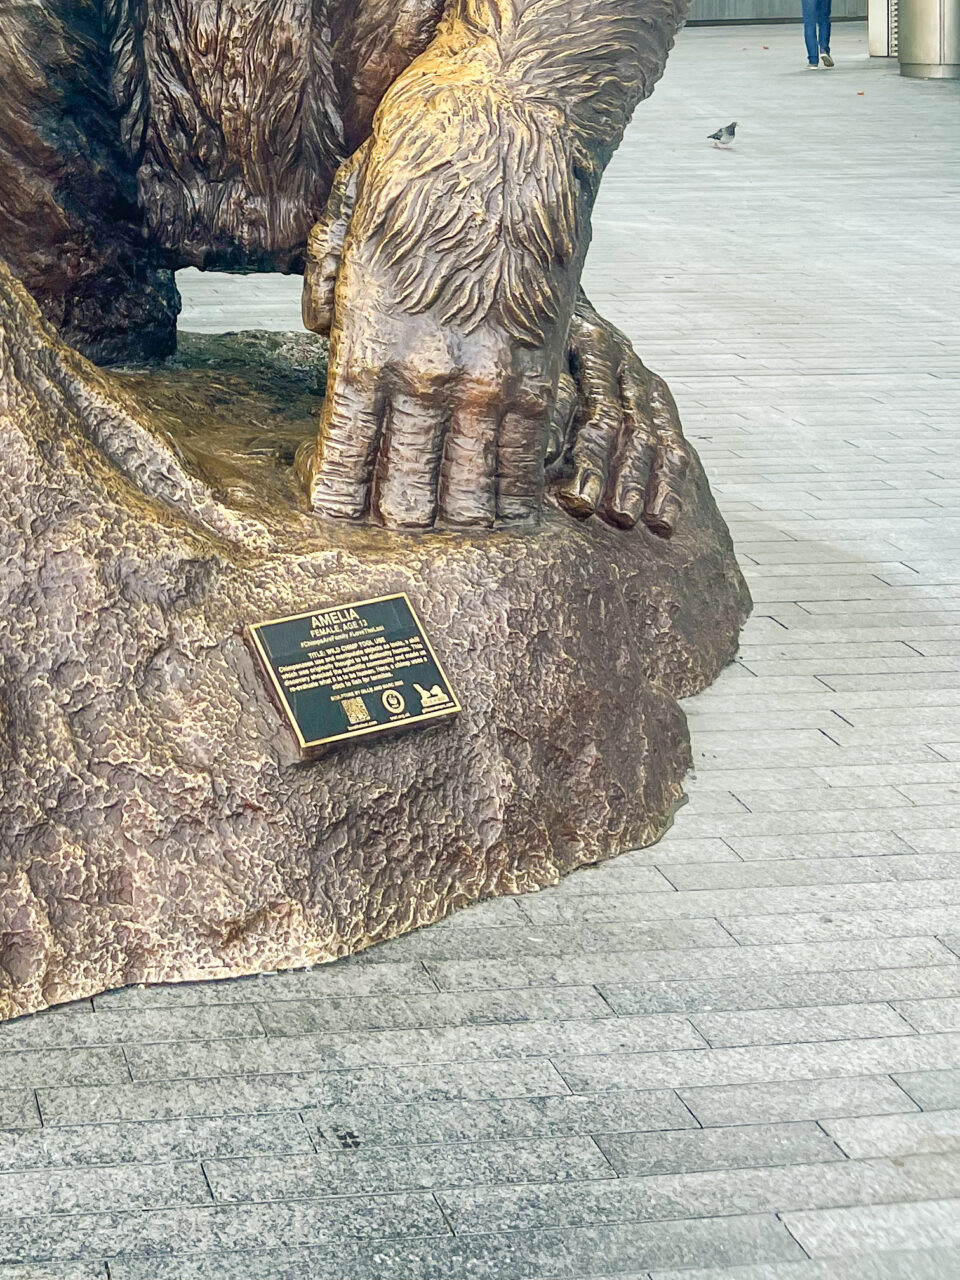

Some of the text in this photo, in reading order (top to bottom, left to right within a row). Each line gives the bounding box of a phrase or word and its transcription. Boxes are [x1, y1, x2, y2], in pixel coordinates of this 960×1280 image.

[312, 608, 360, 628] AMELIA
[310, 619, 368, 638] FEMALE, AGE 13
[307, 650, 326, 659] TITLE:
[325, 647, 341, 655] WILD
[341, 643, 358, 652] CHIMP
[358, 640, 374, 648] TOOL
